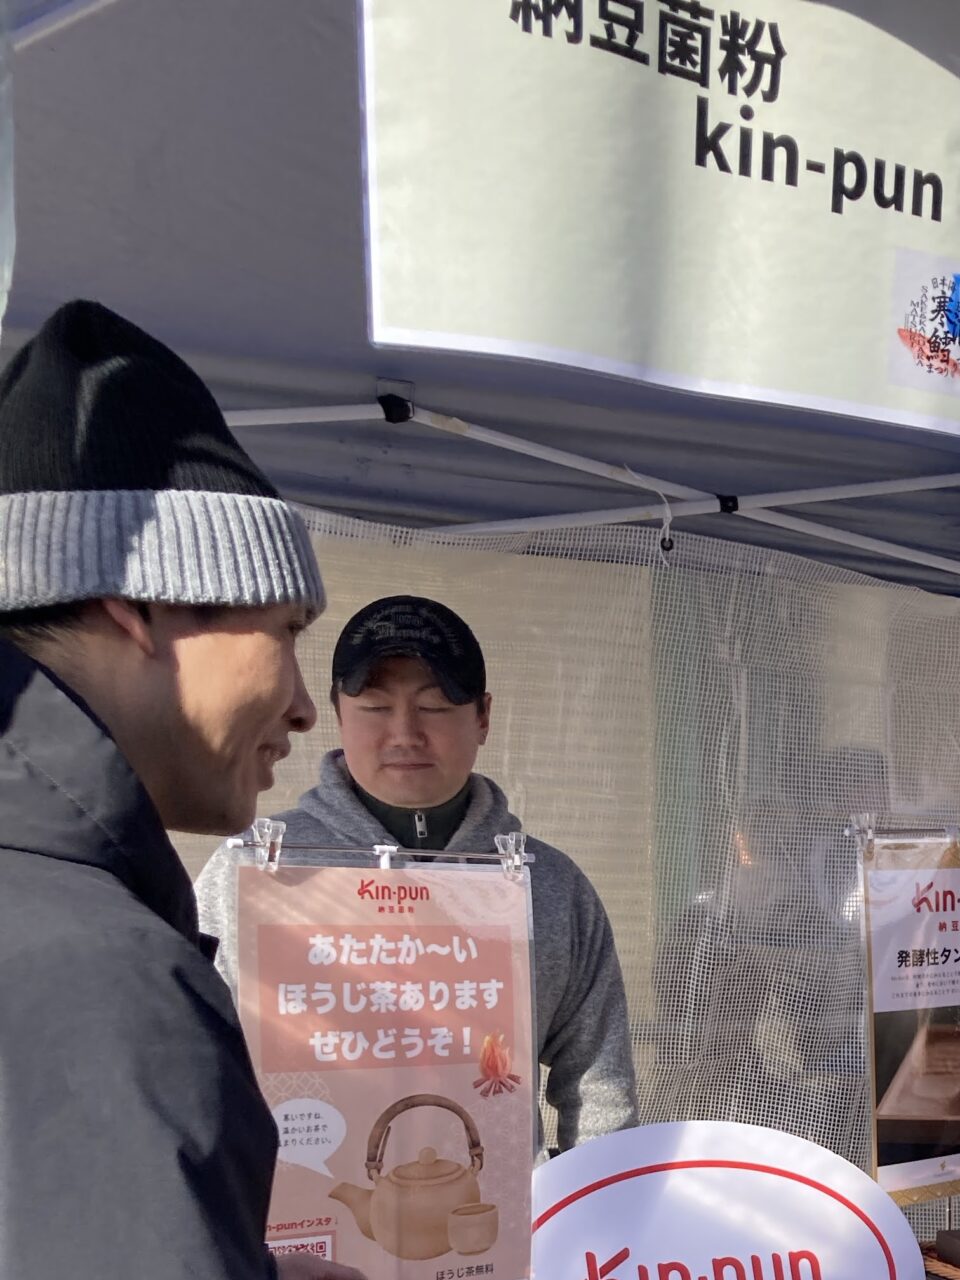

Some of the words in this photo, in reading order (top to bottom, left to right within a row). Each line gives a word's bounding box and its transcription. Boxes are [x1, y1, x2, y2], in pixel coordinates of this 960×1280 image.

[694, 96, 944, 222] kin-pun
[277, 979, 504, 1016] ほうじ茶あります
[436, 1263, 494, 1280] ほうじ茶無料
